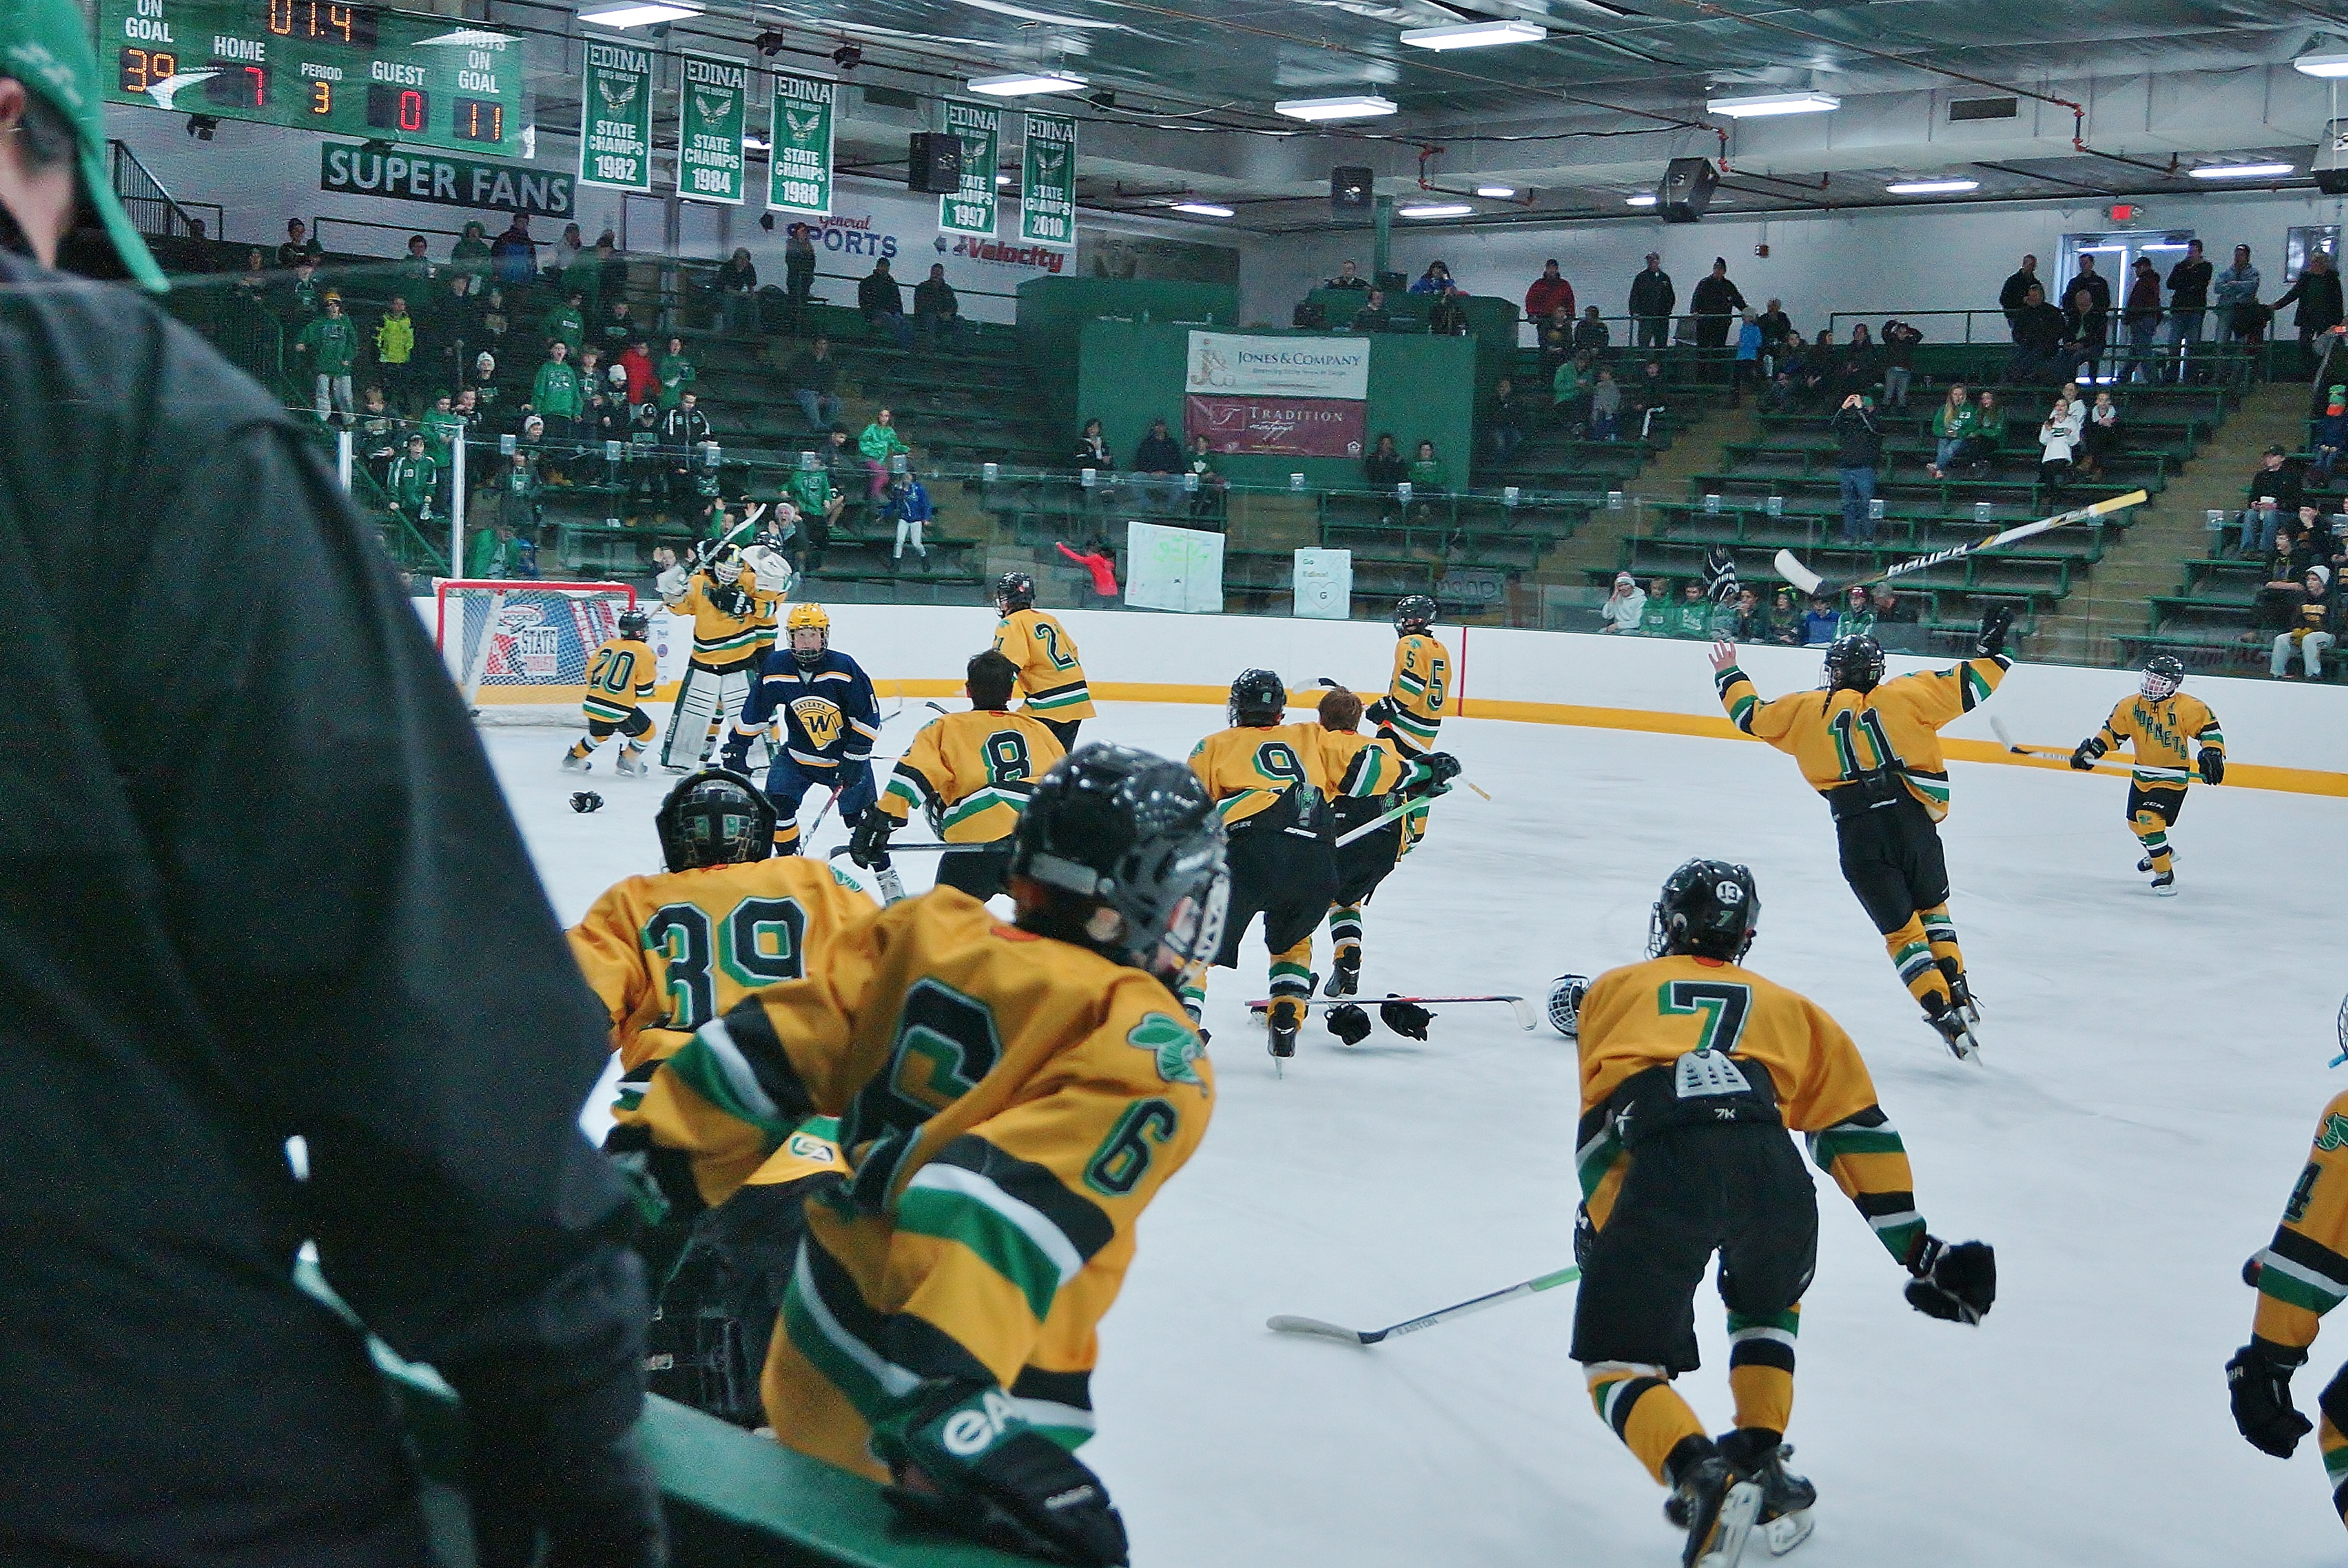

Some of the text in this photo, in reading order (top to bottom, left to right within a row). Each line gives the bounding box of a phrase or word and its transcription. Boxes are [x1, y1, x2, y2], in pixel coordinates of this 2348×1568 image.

[137, 0, 163, 18] ON
[125, 17, 174, 43] GOAL
[213, 35, 265, 62] HOME
[467, 50, 491, 70] ON
[590, 44, 649, 74] EDINA
[127, 48, 174, 94] 39
[301, 62, 343, 81] PERIOD
[372, 60, 426, 86] GUEST
[457, 70, 500, 94] GOAL
[686, 60, 744, 89] EDINA
[245, 66, 263, 106] 7
[315, 81, 330, 114] 3
[776, 76, 831, 104] EDINA
[400, 90, 421, 130] 0
[471, 103, 501, 140] 11
[949, 105, 997, 131] EDINA
[596, 120, 636, 140] STATE
[693, 133, 731, 153] STATE
[1027, 117, 1074, 143] EDINA
[588, 135, 644, 157] CHAMPS
[684, 148, 740, 169] CHAMPS
[783, 147, 820, 166] STATE
[329, 149, 569, 214] SUPER FANS
[595, 155, 637, 182] 1982
[692, 168, 731, 193] 1984
[775, 162, 826, 182] CHAMPS
[959, 173, 986, 190] TATE
[781, 180, 820, 207] 1988
[1033, 184, 1064, 201] STATE
[952, 204, 986, 228] 1997
[1024, 197, 1071, 216] CHAMPS
[1033, 215, 1064, 238] 2010
[1250, 406, 1342, 421] TRADITION
[590, 648, 636, 695] 20
[1405, 651, 1415, 669] 5
[1427, 657, 1445, 711] 5
[804, 715, 831, 734] W
[2133, 703, 2188, 761] HORNETS
[979, 729, 1033, 783] 8
[1827, 706, 1907, 782] 11
[1251, 740, 1308, 784] 9
[1719, 884, 1738, 901] 13
[640, 894, 807, 1034] 39
[1657, 979, 1754, 1054] 7
[1083, 1096, 1181, 1198] 6
